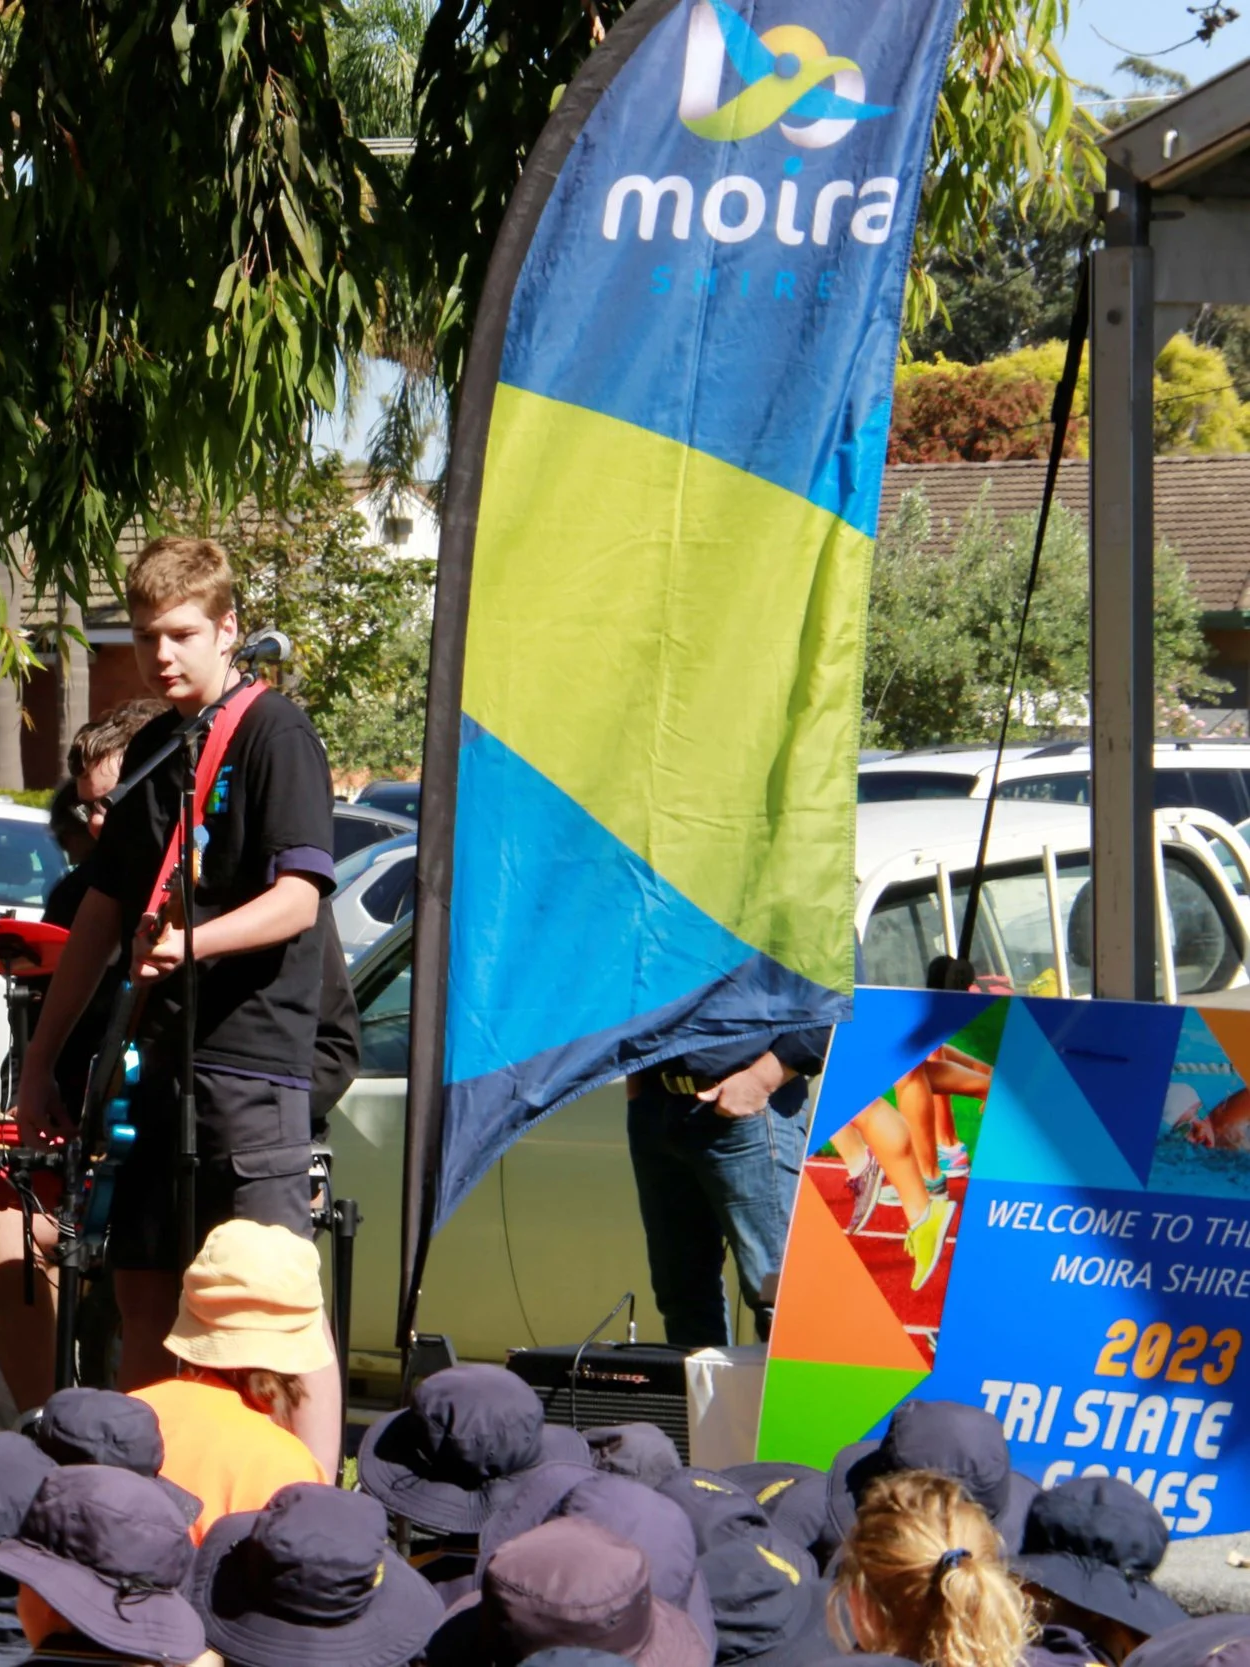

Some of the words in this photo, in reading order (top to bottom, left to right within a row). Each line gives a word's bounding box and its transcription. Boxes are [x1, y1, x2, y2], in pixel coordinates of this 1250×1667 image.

[603, 155, 899, 246] moira
[649, 264, 837, 301] SHIRE
[987, 1199, 1142, 1240] WELCOME
[1151, 1212, 1194, 1244] TO
[1051, 1254, 1152, 1291] MOIRA
[1162, 1263, 1250, 1299] SHIRE
[1093, 1318, 1243, 1386] 2023
[980, 1379, 1063, 1444] TRI
[1063, 1388, 1235, 1460] STATE
